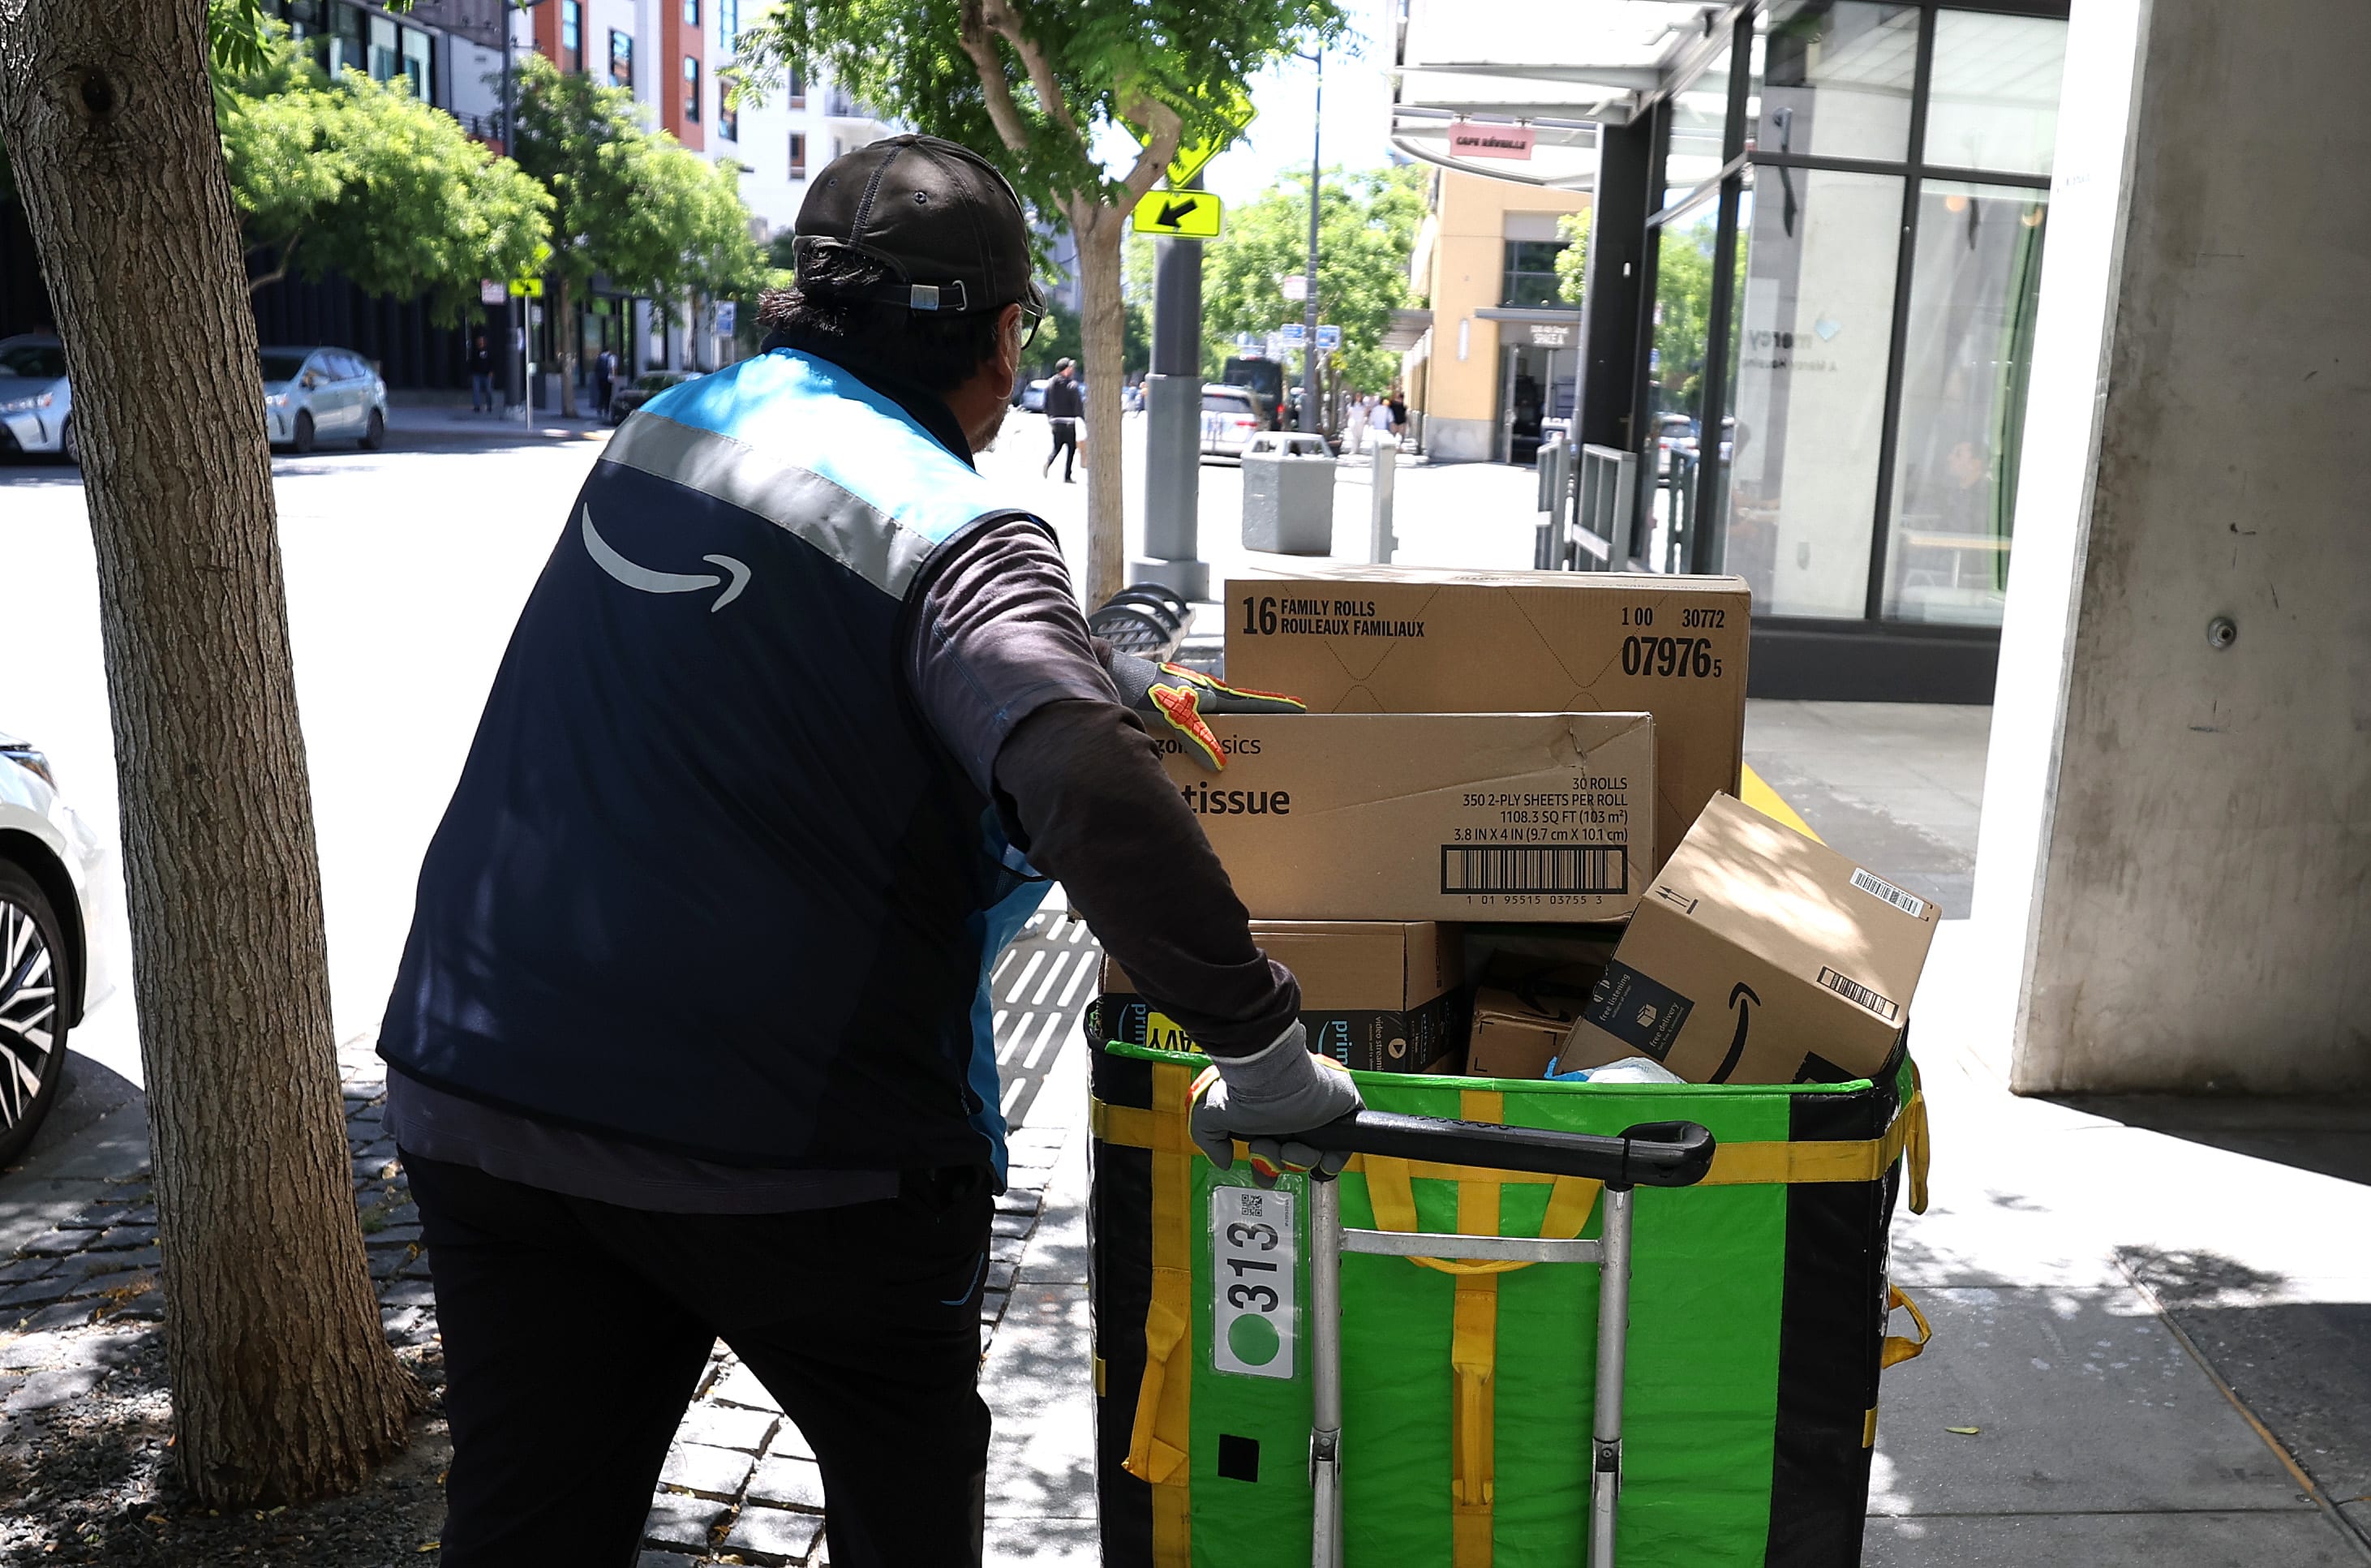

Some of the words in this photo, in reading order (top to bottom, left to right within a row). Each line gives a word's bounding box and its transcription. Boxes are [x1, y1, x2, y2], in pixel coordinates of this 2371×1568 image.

[1243, 596, 1278, 635] 16
[1281, 599, 1329, 616] FAMILY
[1334, 600, 1375, 617] ROLLS
[1621, 607, 1629, 625] 1
[1634, 607, 1653, 626] 00
[1682, 608, 1725, 628] 30772
[1281, 618, 1349, 636] ROULEAUX
[1354, 620, 1424, 637] FAMILIAUX
[1220, 734, 1261, 754] sics
[1573, 778, 1587, 790] 30
[1590, 778, 1627, 790] ROLLS
[1182, 781, 1290, 815] tissue
[1463, 794, 1485, 806] 350
[1488, 794, 1521, 806] 2-PLY
[1524, 794, 1569, 806] SHEETS
[1572, 794, 1594, 806] PER
[1597, 794, 1628, 806] ROLL
[1501, 811, 1539, 823] 1108.3
[1542, 811, 1559, 825] SQ
[1562, 811, 1576, 823] FT
[1579, 810, 1604, 824] (103
[1454, 829, 1472, 841] 3.8
[1475, 828, 1487, 840] IN
[1490, 828, 1497, 840] X
[1501, 828, 1508, 840] 4
[1511, 828, 1523, 840] IN
[1526, 828, 1548, 842] (9.7
[1551, 831, 1568, 840] cm
[1571, 828, 1579, 840] X
[1583, 828, 1604, 840] 10.1
[1607, 828, 1628, 842] cm)
[1481, 896, 1494, 904] 01
[1504, 896, 1540, 904] 95515
[1550, 896, 1587, 904] 03755
[1596, 896, 1602, 904] 3
[1599, 1006, 1612, 1021] free
[1608, 973, 1630, 1006] listening
[1131, 1003, 1146, 1046] prim
[1375, 1016, 1384, 1038] video
[1649, 1031, 1662, 1047] free
[1659, 1003, 1679, 1033] delivery
[1149, 1028, 1196, 1053] AVY
[1331, 1020, 1353, 1064] prim
[1375, 1040, 1384, 1072] streami
[1226, 1222, 1278, 1312] 313
